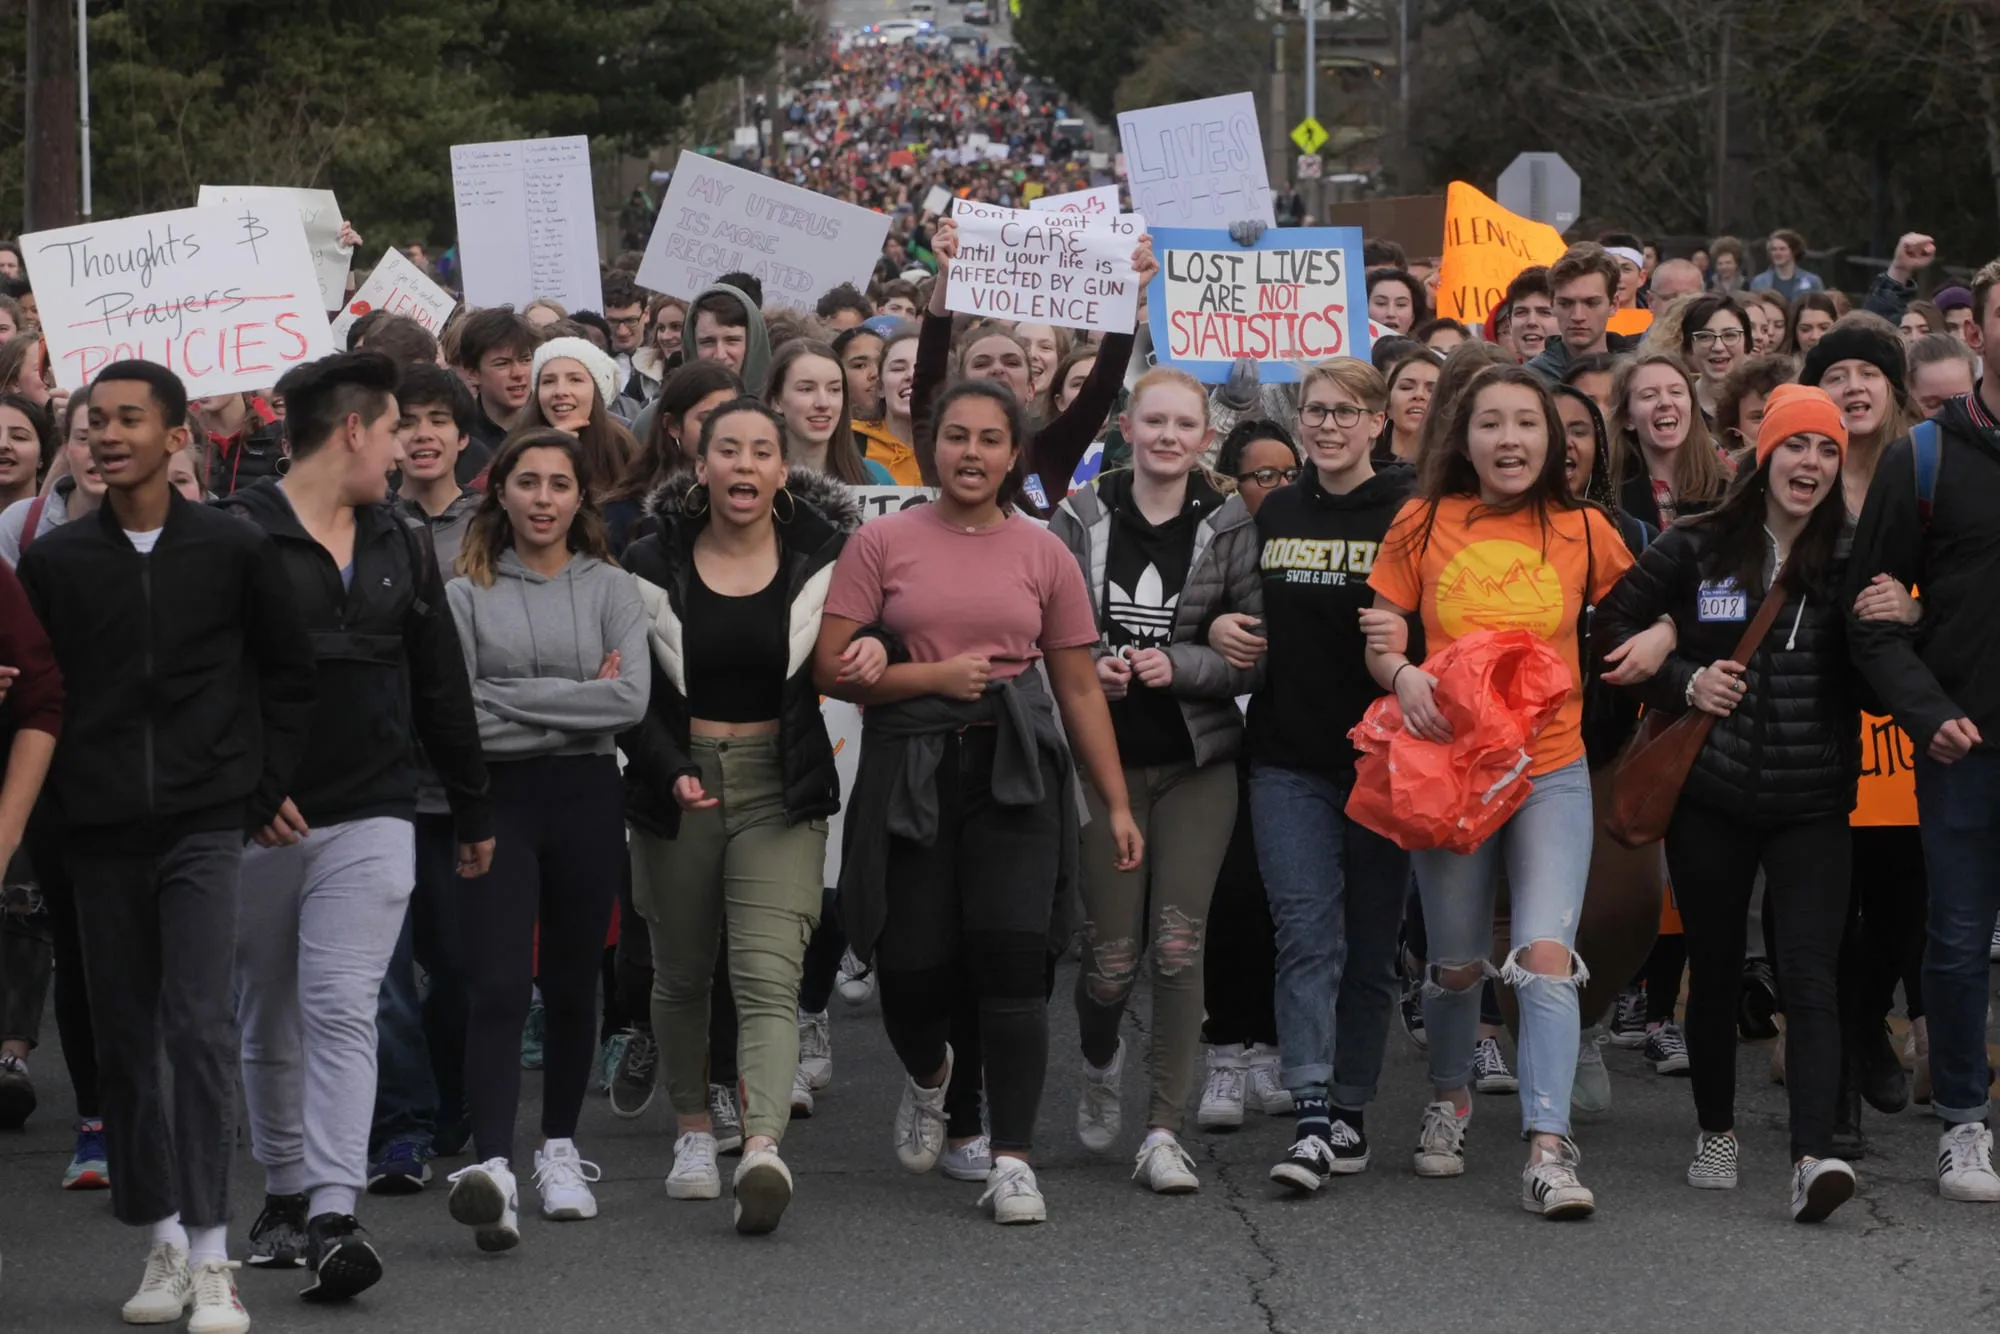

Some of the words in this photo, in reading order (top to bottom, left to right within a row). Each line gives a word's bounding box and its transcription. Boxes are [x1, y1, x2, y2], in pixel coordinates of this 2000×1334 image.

[1123, 112, 1255, 184] LIVES
[687, 174, 735, 207] MY
[745, 193, 842, 240] UTERUS
[1045, 215, 1090, 229] wait
[1110, 216, 1134, 234] to
[676, 206, 711, 236] IS
[712, 220, 780, 255] MORE
[1001, 222, 1087, 254] CARE
[39, 223, 201, 289] Thoughts
[953, 244, 996, 261] until
[1005, 251, 1050, 273] your
[1059, 251, 1084, 270] life
[1095, 259, 1113, 275] is
[1167, 250, 1244, 284] LOST
[1256, 250, 1341, 286] LIVES
[950, 265, 1042, 290] AFFECTED
[1051, 273, 1074, 293] BY
[1084, 278, 1125, 296] GUN
[1199, 283, 1247, 313] ARE
[1259, 284, 1305, 311] NOT
[84, 287, 245, 340] Prayers
[971, 287, 1100, 324] VIOLENCE
[1170, 304, 1345, 359] STATISTICS
[1260, 538, 1382, 574] ROOSEVEL
[1285, 569, 1312, 583] SWIM
[1312, 570, 1320, 584] &
[1321, 571, 1347, 585] DIVE
[1701, 598, 1739, 617] 2018
